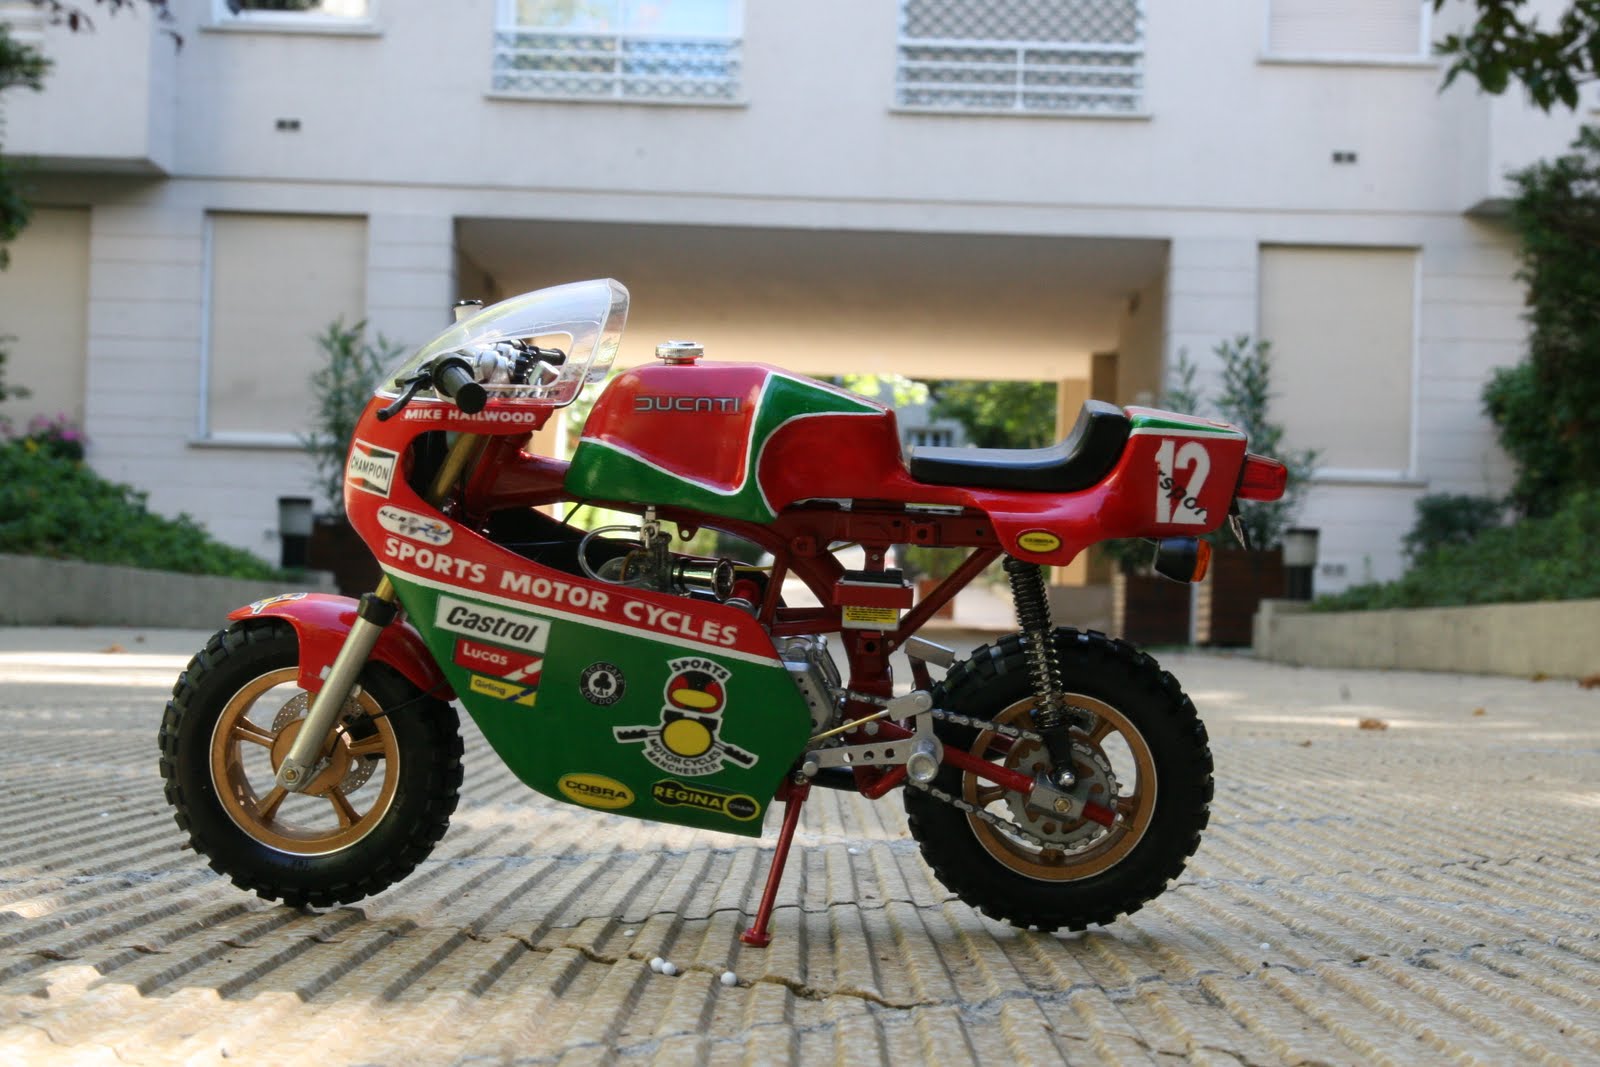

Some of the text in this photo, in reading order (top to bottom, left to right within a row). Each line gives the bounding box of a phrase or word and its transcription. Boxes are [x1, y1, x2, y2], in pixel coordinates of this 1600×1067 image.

[404, 409, 536, 423] MIKE HAILWOOD
[634, 397, 739, 412] DUCATI
[350, 455, 389, 481] CHAMPION
[1155, 438, 1211, 525] 12
[385, 537, 738, 645] SPORTS MOTOR CYCLES
[446, 606, 539, 643] Castrol
[463, 642, 508, 665] Lucas
[585, 664, 603, 678] ACE
[671, 659, 728, 679] SPORTS
[582, 687, 618, 705] LONDON
[647, 751, 719, 775] MANCHESTER
[649, 739, 721, 766] MOTOR CYCLES
[565, 780, 628, 800] COBRA
[653, 786, 722, 809] REGINA
